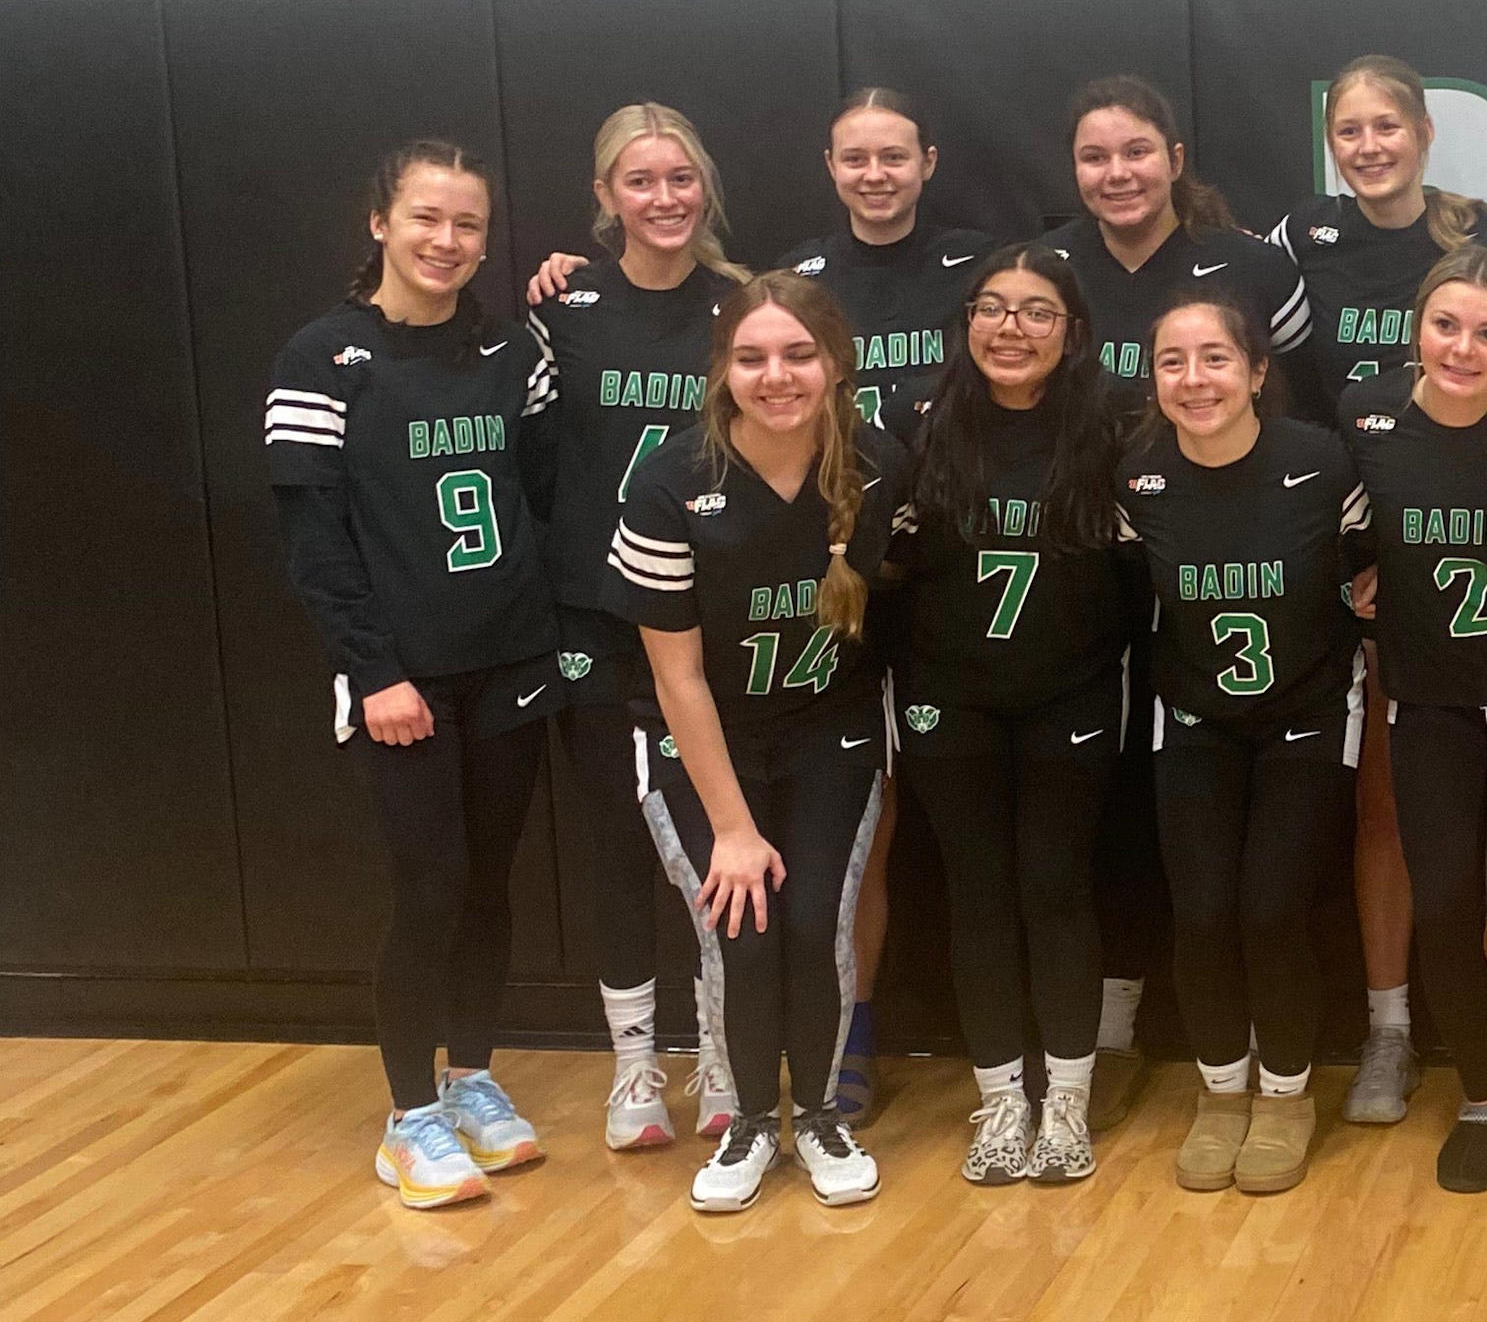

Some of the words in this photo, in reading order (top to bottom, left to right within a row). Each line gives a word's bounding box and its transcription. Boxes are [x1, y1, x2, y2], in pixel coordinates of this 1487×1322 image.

[567, 290, 601, 306] FLAG
[1337, 308, 1414, 344] BADI
[600, 370, 708, 412] BADIN
[409, 415, 505, 459] BADIN
[1364, 417, 1396, 432] FLAG
[694, 494, 727, 514] FLAG
[1136, 479, 1167, 493] FLAG
[436, 469, 503, 573] 9
[749, 579, 818, 622] BAD
[978, 551, 1040, 639] 7
[1180, 560, 1285, 602] BADIN
[740, 625, 841, 696] 14
[1211, 613, 1275, 696] 3
